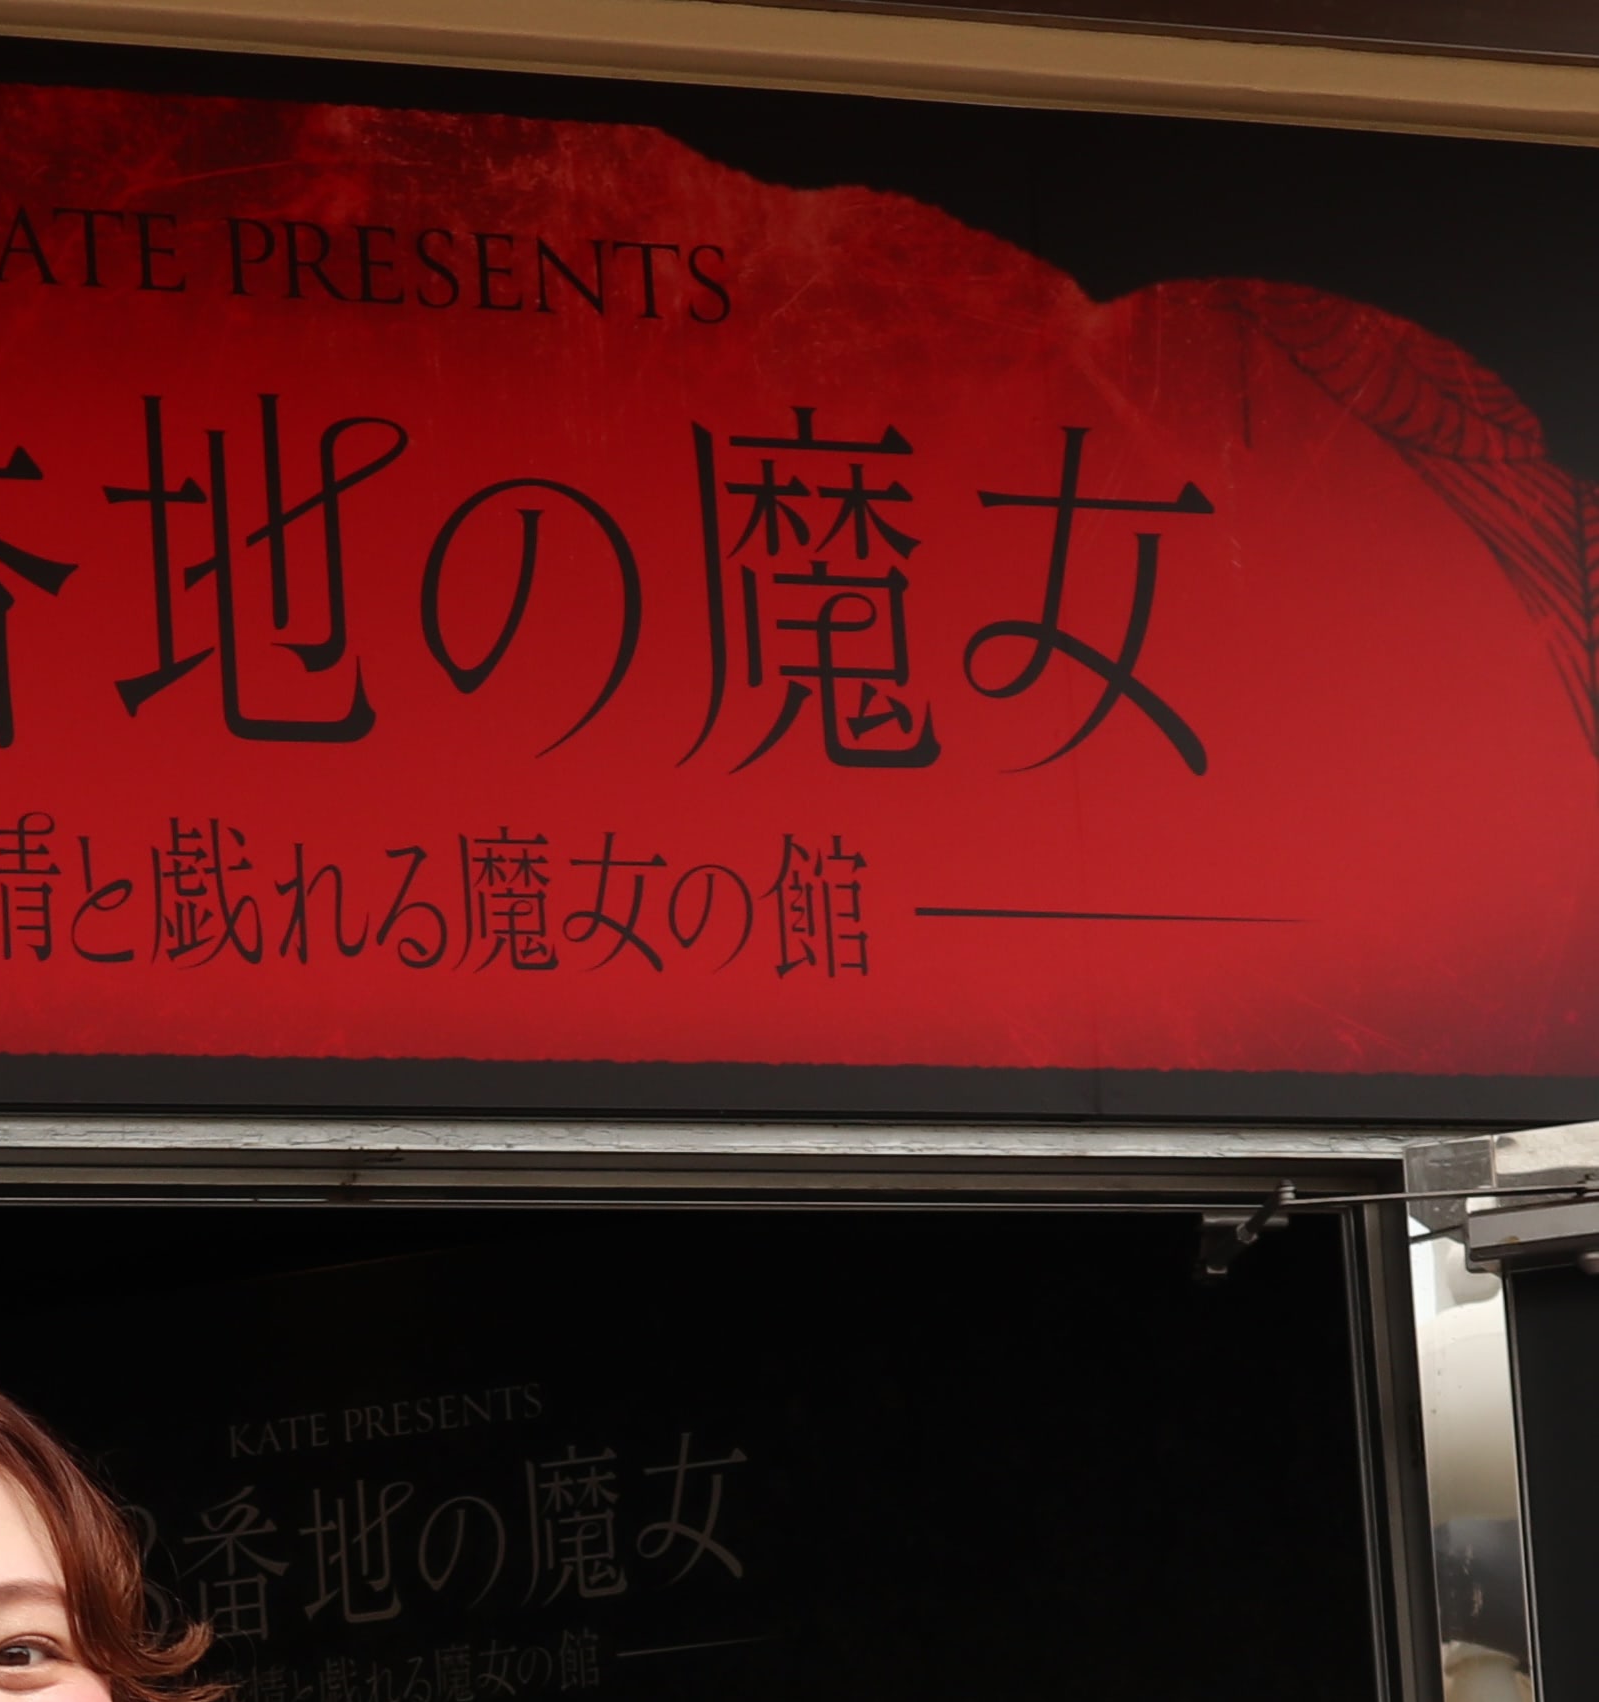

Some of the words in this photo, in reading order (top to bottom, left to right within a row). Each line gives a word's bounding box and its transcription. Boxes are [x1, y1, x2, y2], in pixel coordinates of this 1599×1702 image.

[227, 217, 732, 325] PRESENTS
[228, 1411, 330, 1459] KATE
[343, 1383, 545, 1442] PRESENTS
